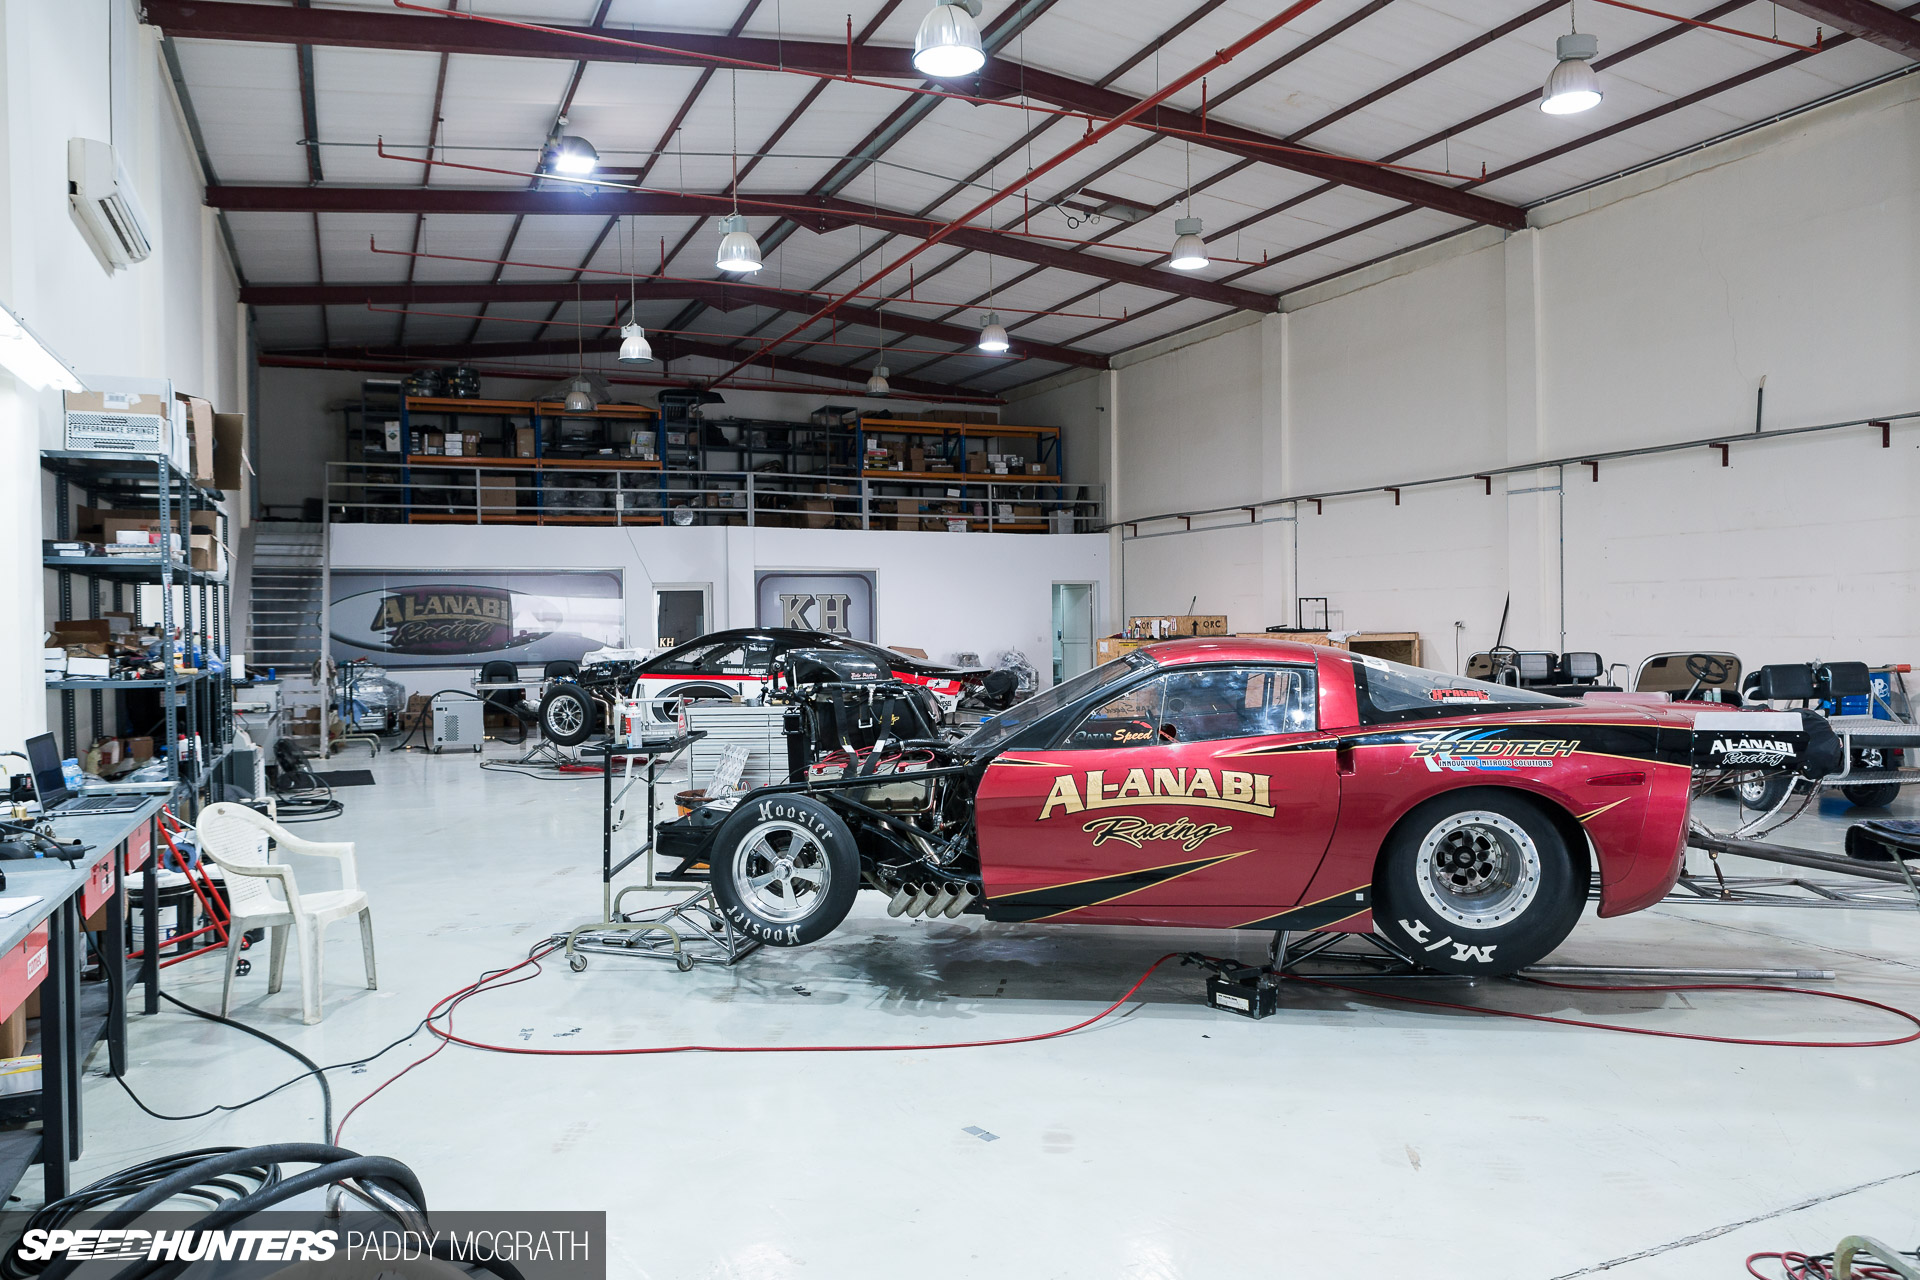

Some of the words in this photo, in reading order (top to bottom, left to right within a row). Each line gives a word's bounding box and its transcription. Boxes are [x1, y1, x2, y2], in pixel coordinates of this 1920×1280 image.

[73, 425, 124, 433] PERFORMANCE
[371, 594, 513, 630] AL-ANABI
[780, 593, 851, 637] KH
[392, 619, 495, 646] Racing
[659, 637, 675, 647] KH
[1113, 728, 1154, 744] Speed
[1410, 739, 1581, 758] SPEEDTECH
[1710, 739, 1797, 757] AL-ANABI
[1722, 752, 1785, 767] Racing
[1438, 759, 1480, 768] INNOVATIVE
[1482, 759, 1512, 768] NITROUS
[1513, 759, 1553, 768] SOLUTIONS
[1035, 767, 1277, 821] AL-ANABI
[757, 800, 834, 840] Hoosier
[1082, 815, 1233, 852] Racing
[726, 905, 802, 945] Hoosier
